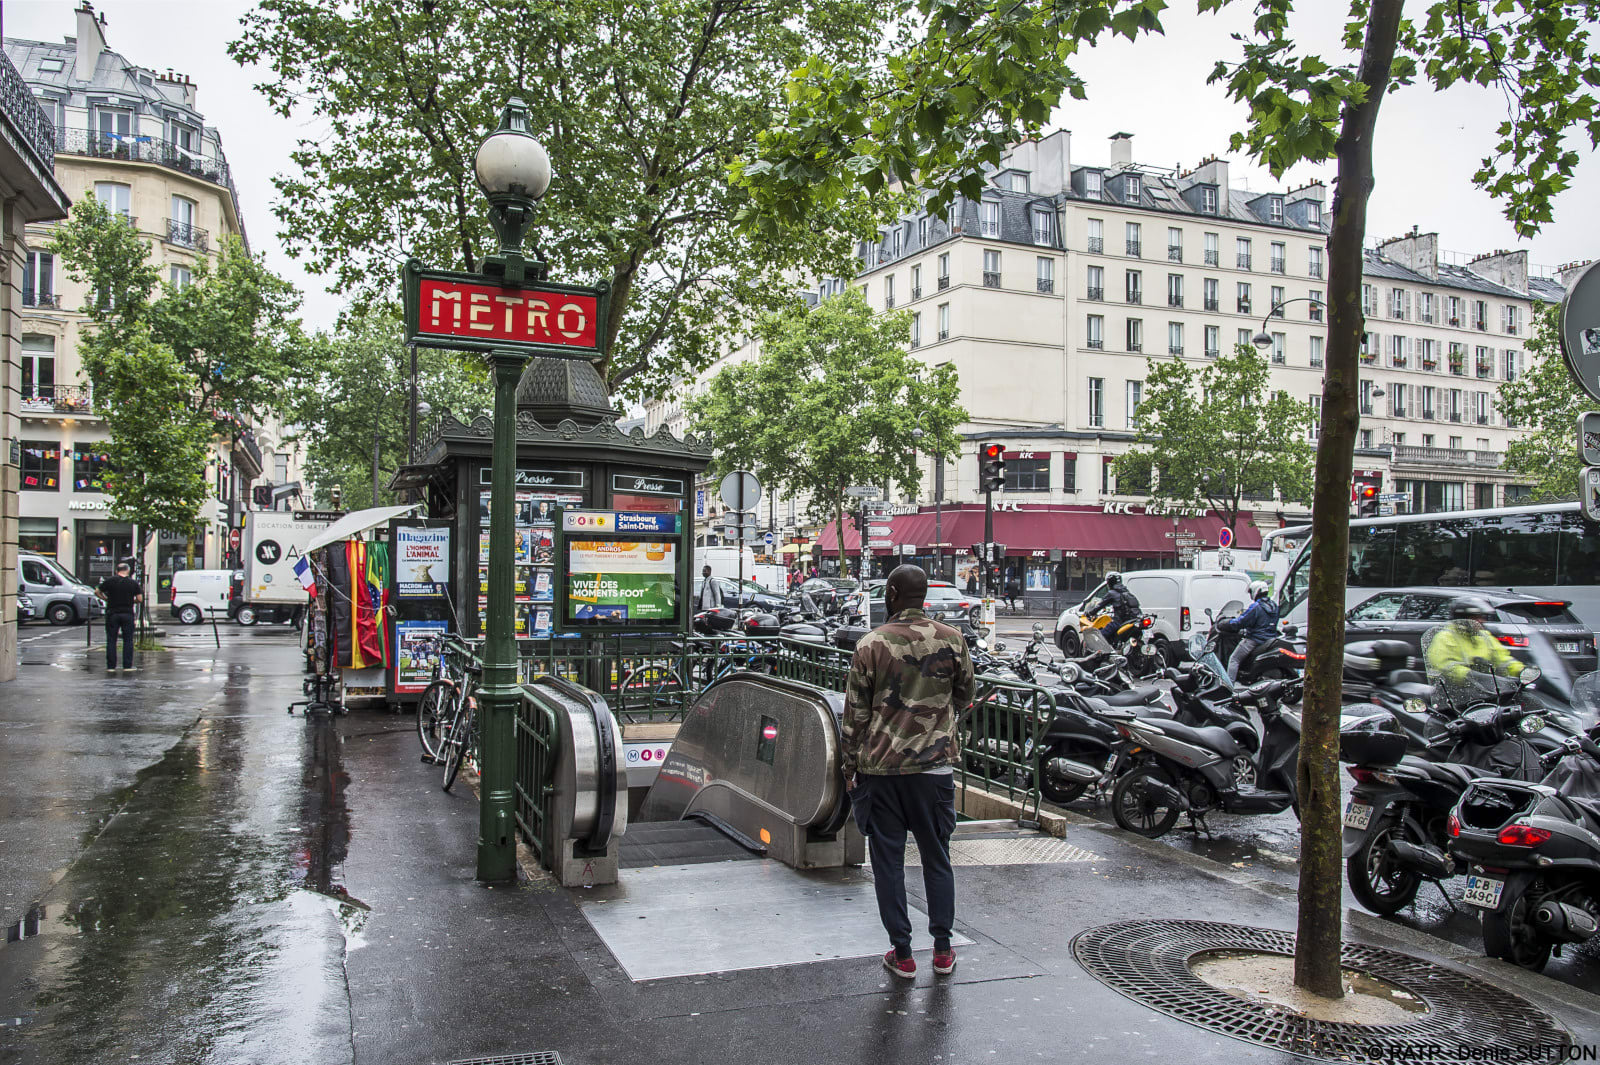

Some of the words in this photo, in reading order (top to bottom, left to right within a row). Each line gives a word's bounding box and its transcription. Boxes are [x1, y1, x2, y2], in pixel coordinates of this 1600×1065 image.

[431, 288, 586, 339] METRO
[515, 471, 555, 484] Presse
[633, 478, 664, 491] Presse
[991, 500, 1023, 511] KFC
[1103, 501, 1135, 515] KFC
[618, 513, 657, 524] Strasbourg
[618, 521, 659, 531] Saint-Denis
[398, 532, 449, 542] Magazine
[573, 580, 599, 589] VIVEZ
[600, 581, 618, 589] DES
[573, 589, 618, 597] MOMENTS
[620, 589, 645, 597] FOOT
